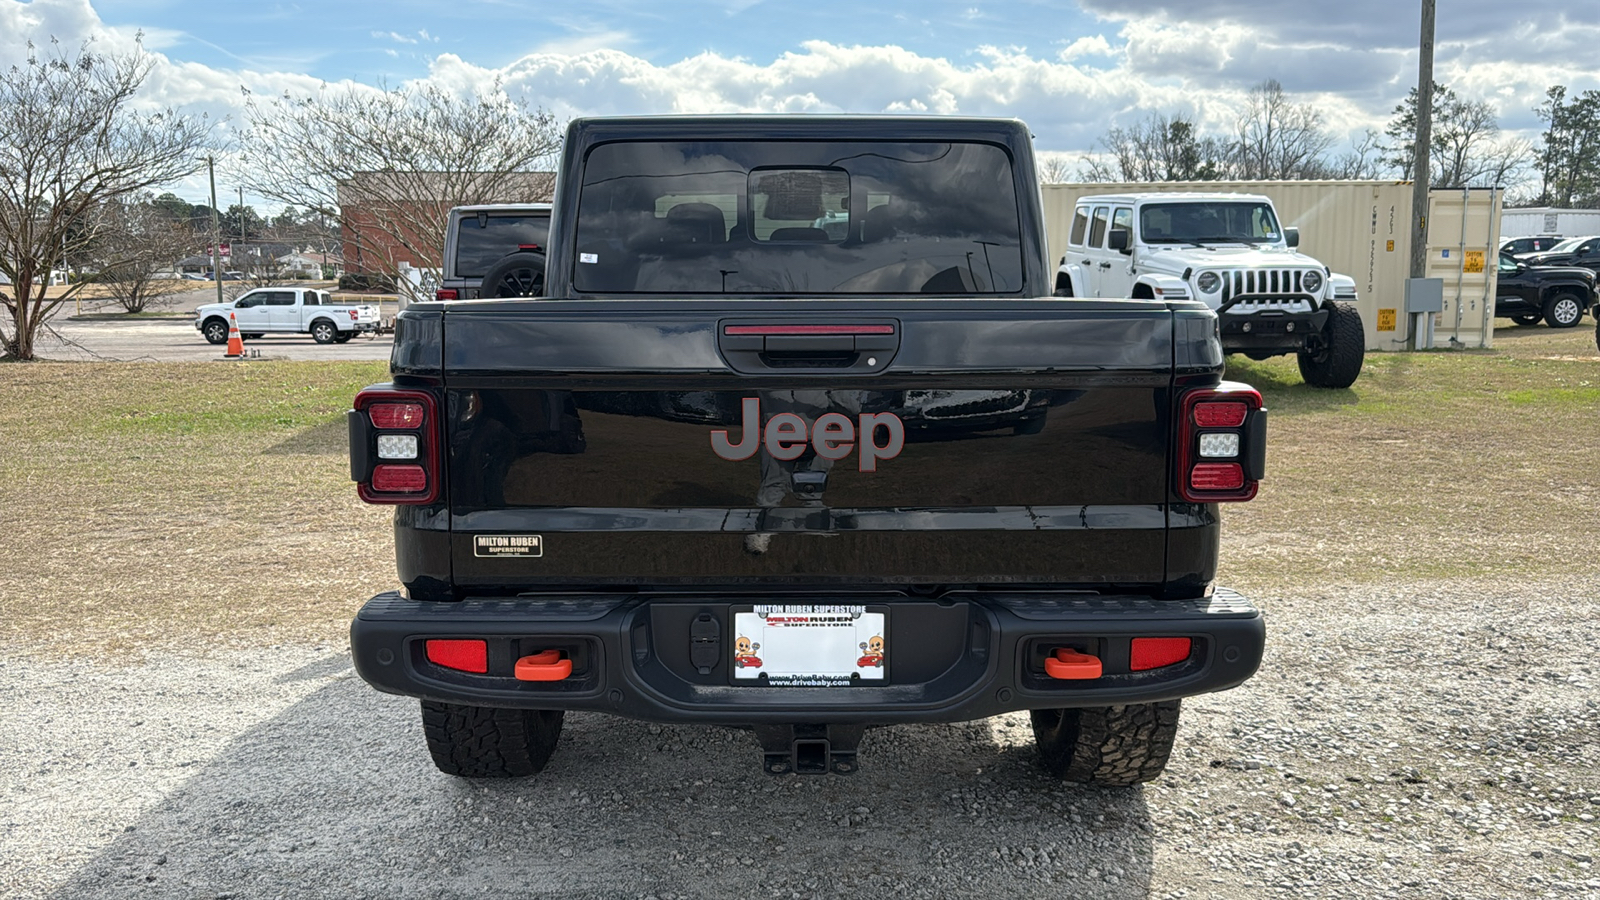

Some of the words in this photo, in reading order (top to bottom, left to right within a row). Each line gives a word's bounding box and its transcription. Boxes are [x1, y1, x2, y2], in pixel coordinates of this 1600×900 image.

[710, 397, 905, 472] Jeep
[478, 537, 509, 546] MILTON
[510, 537, 538, 546] RUBEN
[753, 605, 784, 613] MILTON
[785, 605, 813, 613] RUBEN
[813, 605, 866, 613] SUPERSTORE
[769, 679, 850, 688] www.drivebaby.com
